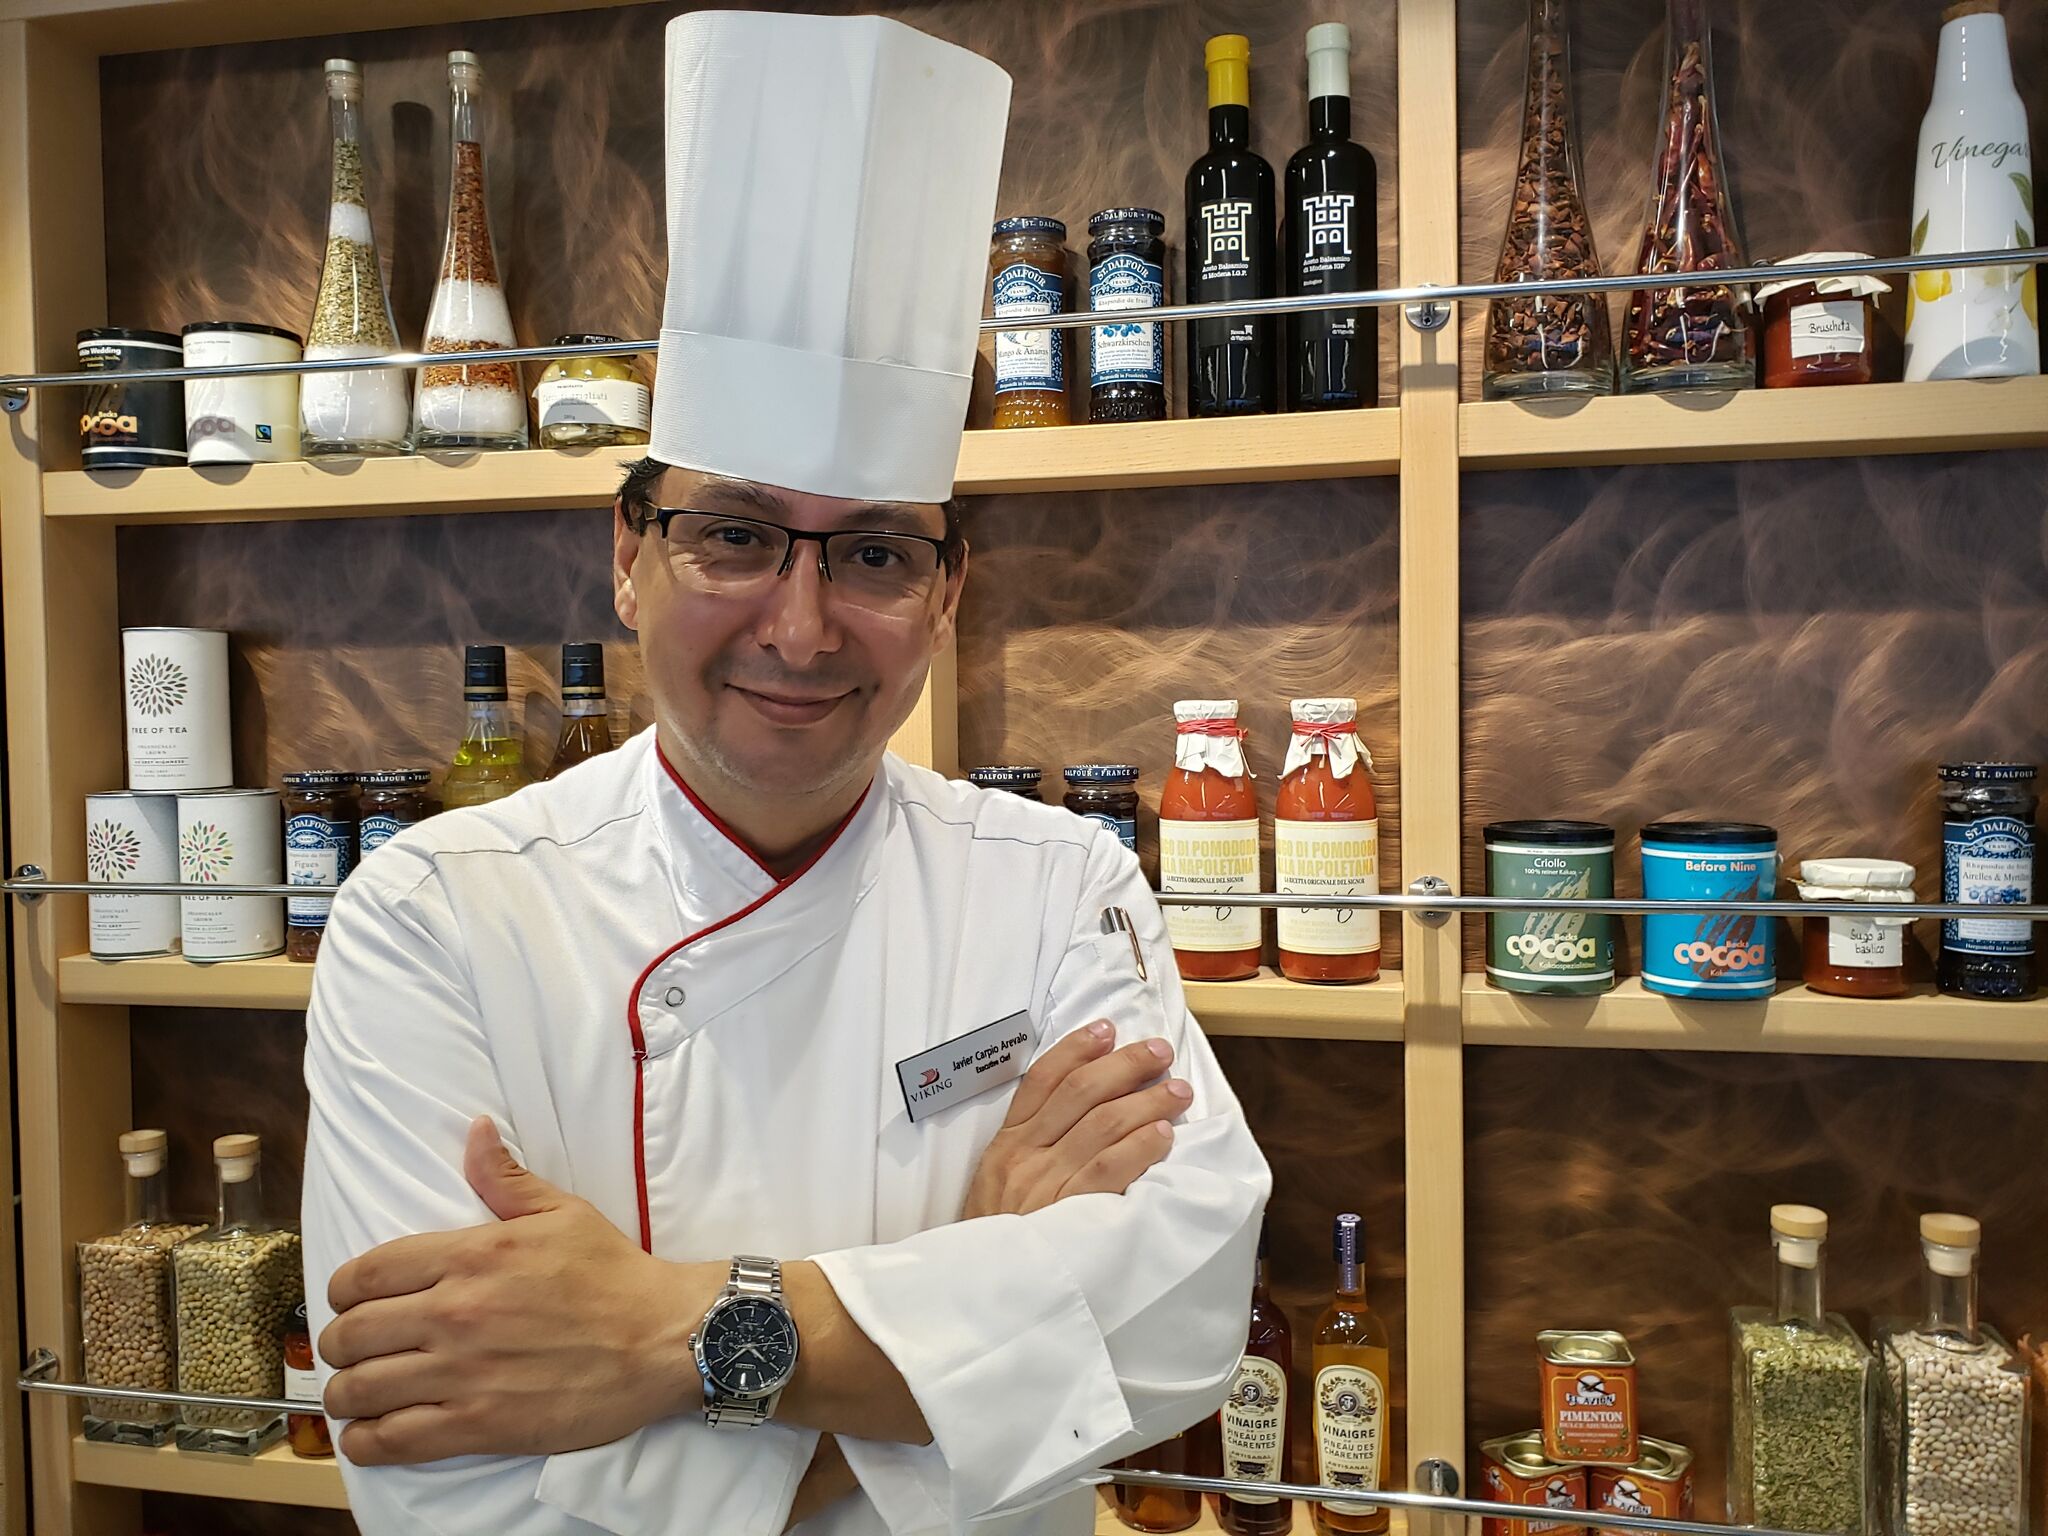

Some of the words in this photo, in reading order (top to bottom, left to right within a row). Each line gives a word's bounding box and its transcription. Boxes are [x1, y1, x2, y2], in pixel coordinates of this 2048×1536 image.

[1097, 267, 1108, 281] ST.
[1108, 259, 1149, 278] DALFOUR
[996, 277, 1006, 290] ST.
[1005, 268, 1046, 287] DALFOUR
[90, 346, 121, 356] Wedding
[1101, 768, 1131, 777] FRANCE
[1974, 770, 1991, 779] ST.
[294, 819, 333, 835] DALFOUR
[366, 821, 402, 834] DALFOU
[1964, 827, 1982, 841] ST.
[1982, 822, 2029, 841] DALFOUR
[1177, 839, 1189, 857] DI
[1295, 841, 1308, 858] DI
[1533, 858, 1567, 868] Criollo
[1685, 860, 1726, 872] Before
[1730, 862, 1756, 872] Nine
[1307, 878, 1336, 886] ORIGINALE
[1963, 872, 1993, 881] Airelles
[1994, 873, 2001, 881] &
[1850, 928, 1873, 944] Sugo
[1877, 929, 1886, 941] al
[1506, 934, 1596, 963] cocoa
[1673, 941, 1765, 970] cocoa
[1855, 943, 1885, 954] basilico
[952, 1056, 974, 1072] Javier
[975, 1044, 999, 1060] Carpio
[1001, 1032, 1028, 1051] Arevalo
[975, 1060, 999, 1074] Executive
[999, 1053, 1011, 1063] Chef
[910, 1078, 953, 1103] VIKING
[1226, 1412, 1277, 1429] VINAIGRE
[1227, 1427, 1256, 1441] PINEAU
[1260, 1433, 1276, 1441] DES
[1322, 1422, 1375, 1439] VINAIGRE
[1228, 1437, 1276, 1449] CHARENTES
[1324, 1438, 1354, 1451] PINEAU
[1357, 1443, 1375, 1451] DES
[1324, 1447, 1374, 1460] CHARENTES
[1328, 1461, 1369, 1470] ARTISANAL
